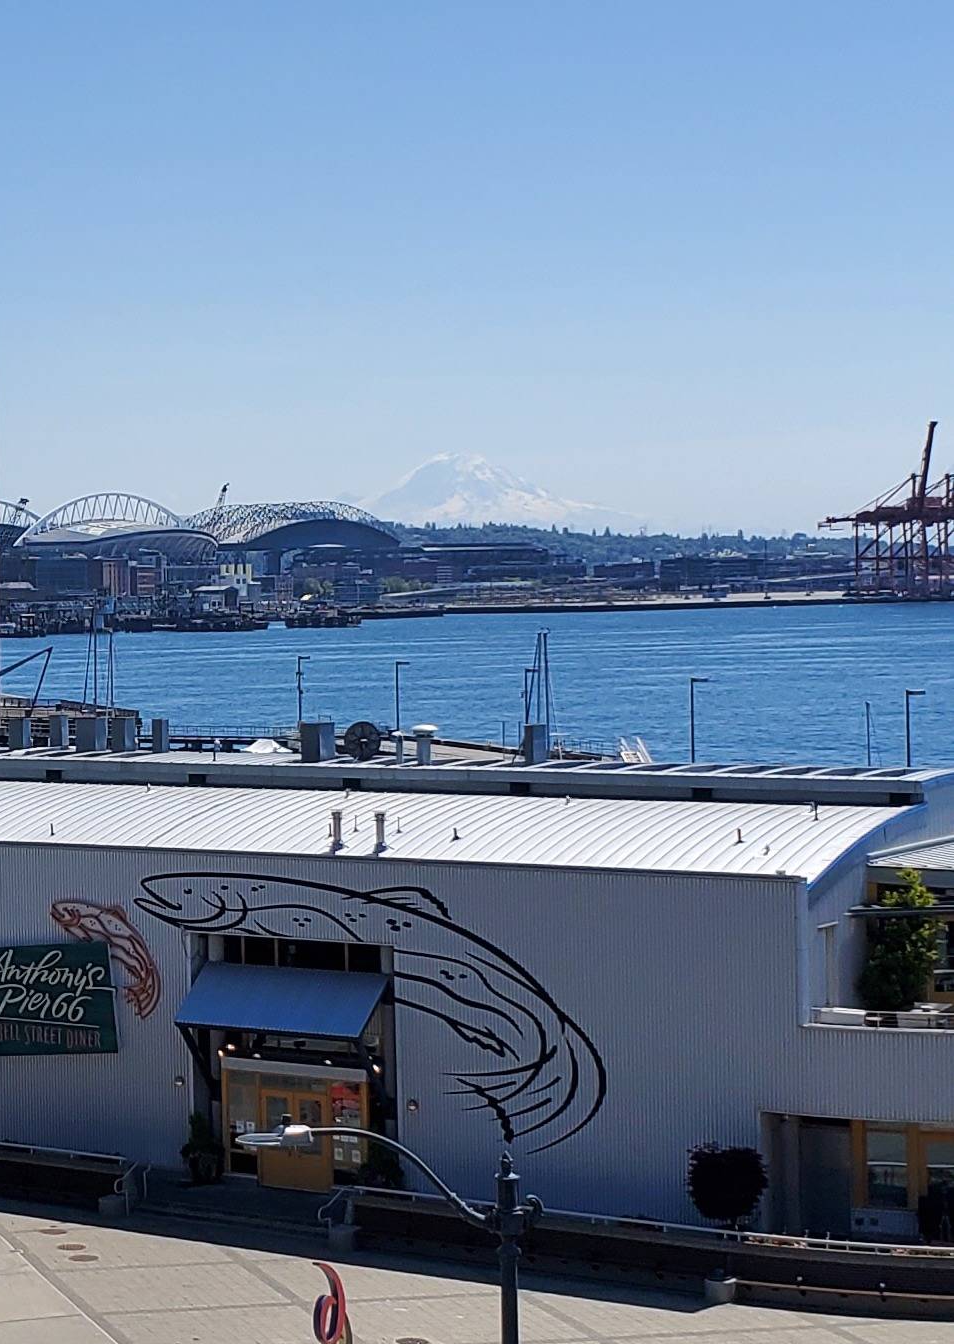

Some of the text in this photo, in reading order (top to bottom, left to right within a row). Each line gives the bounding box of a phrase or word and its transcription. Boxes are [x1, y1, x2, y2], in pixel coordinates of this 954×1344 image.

[51, 995, 92, 1021] 66
[24, 1025, 62, 1045] STREET
[66, 1028, 101, 1048] DINER
